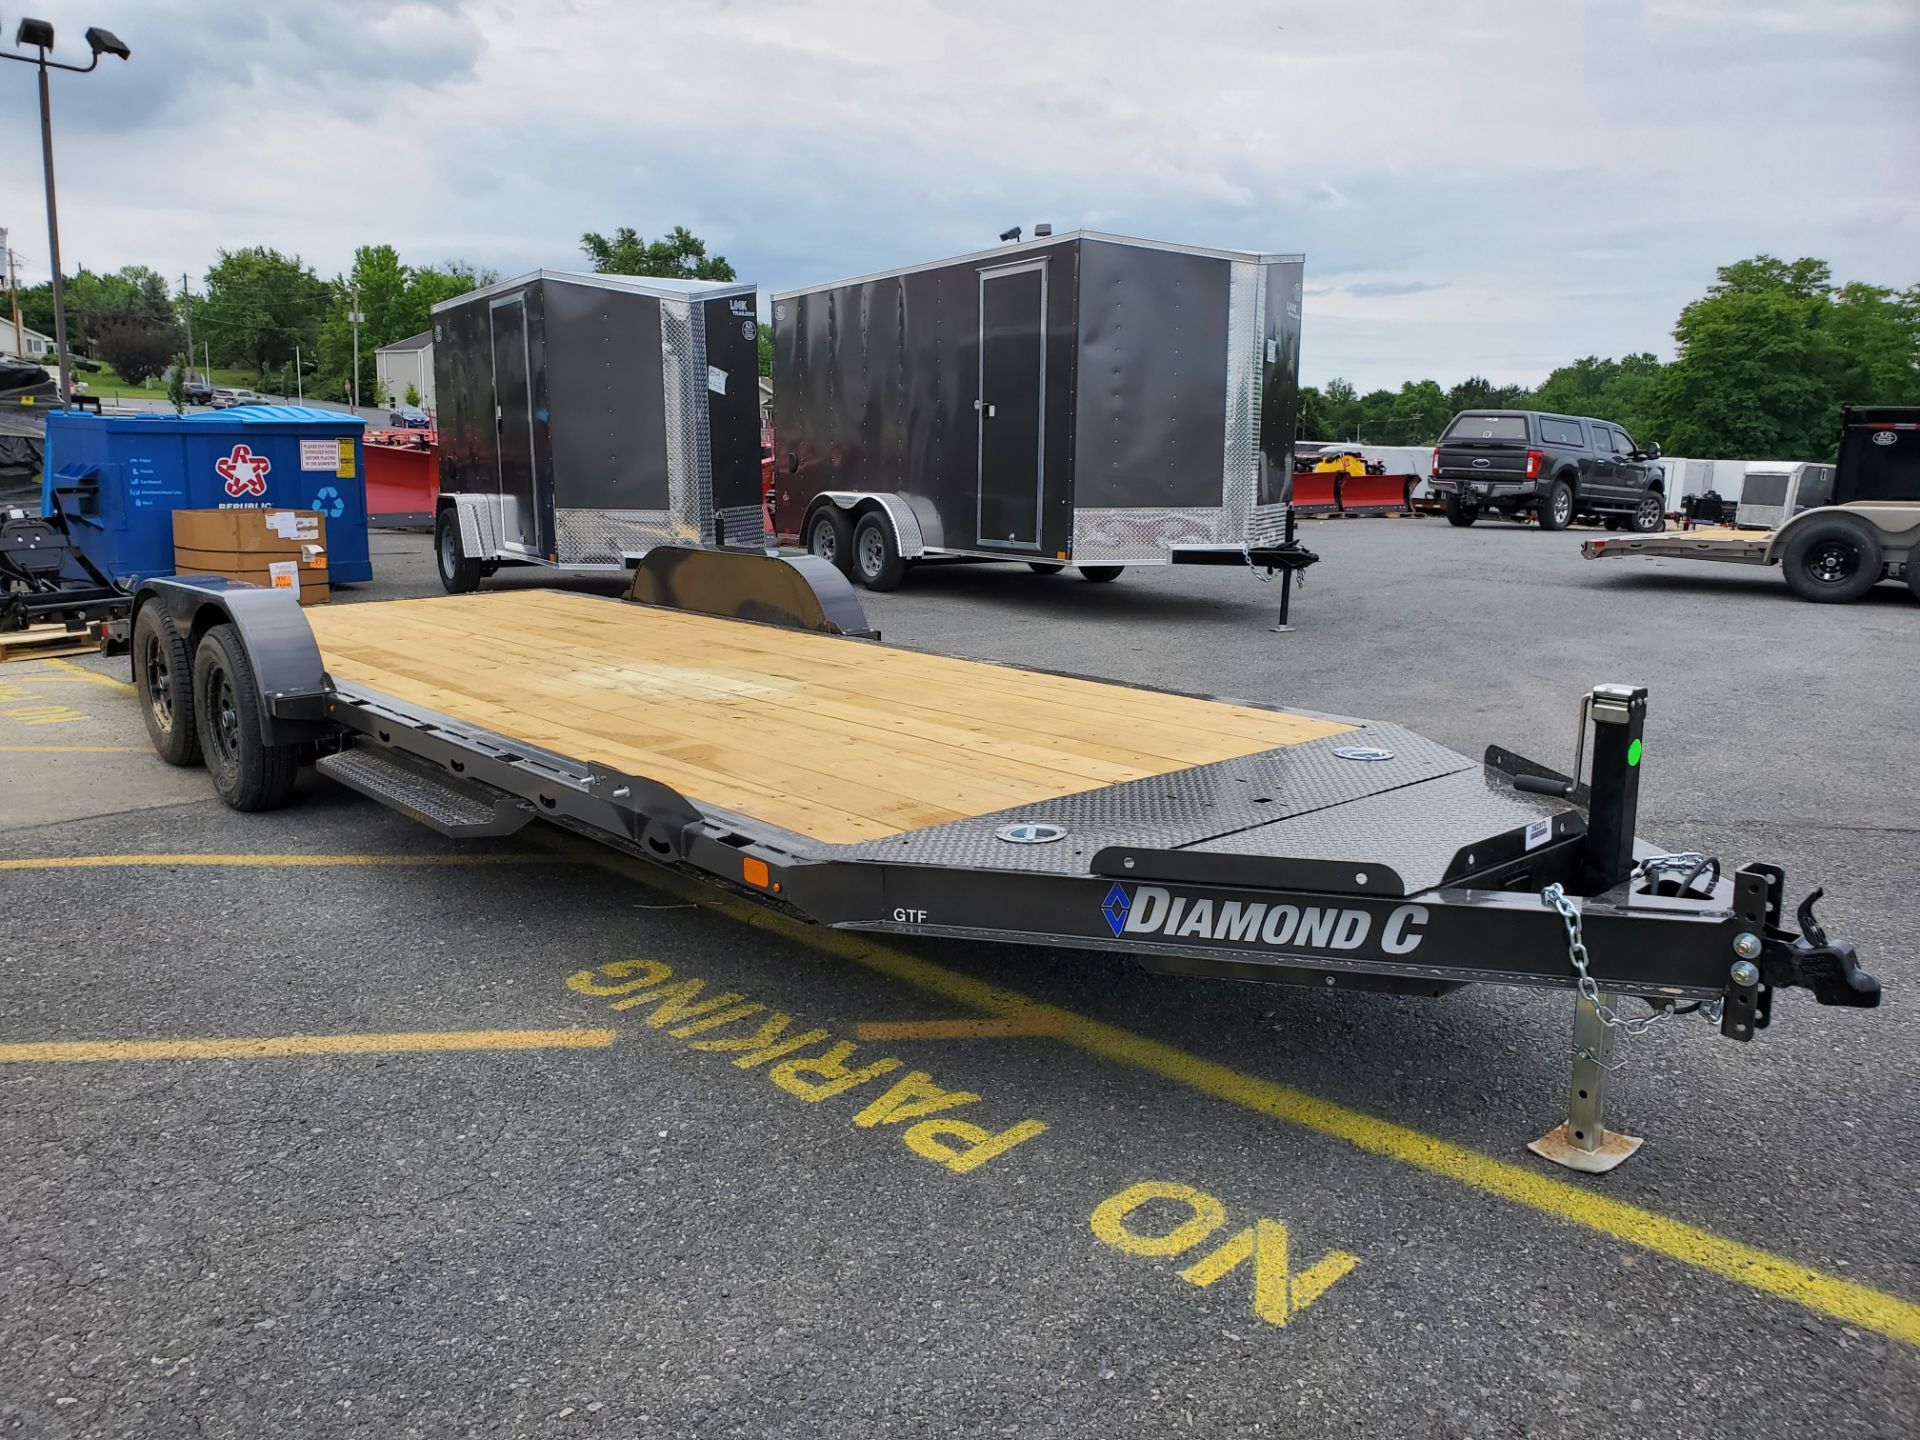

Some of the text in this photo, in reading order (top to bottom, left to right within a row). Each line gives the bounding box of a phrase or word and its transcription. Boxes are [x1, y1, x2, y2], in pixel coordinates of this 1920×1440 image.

[893, 908, 928, 923] GTF
[1124, 886, 1430, 954] DIAMOND C
[565, 959, 1362, 1326] NO PARKING
